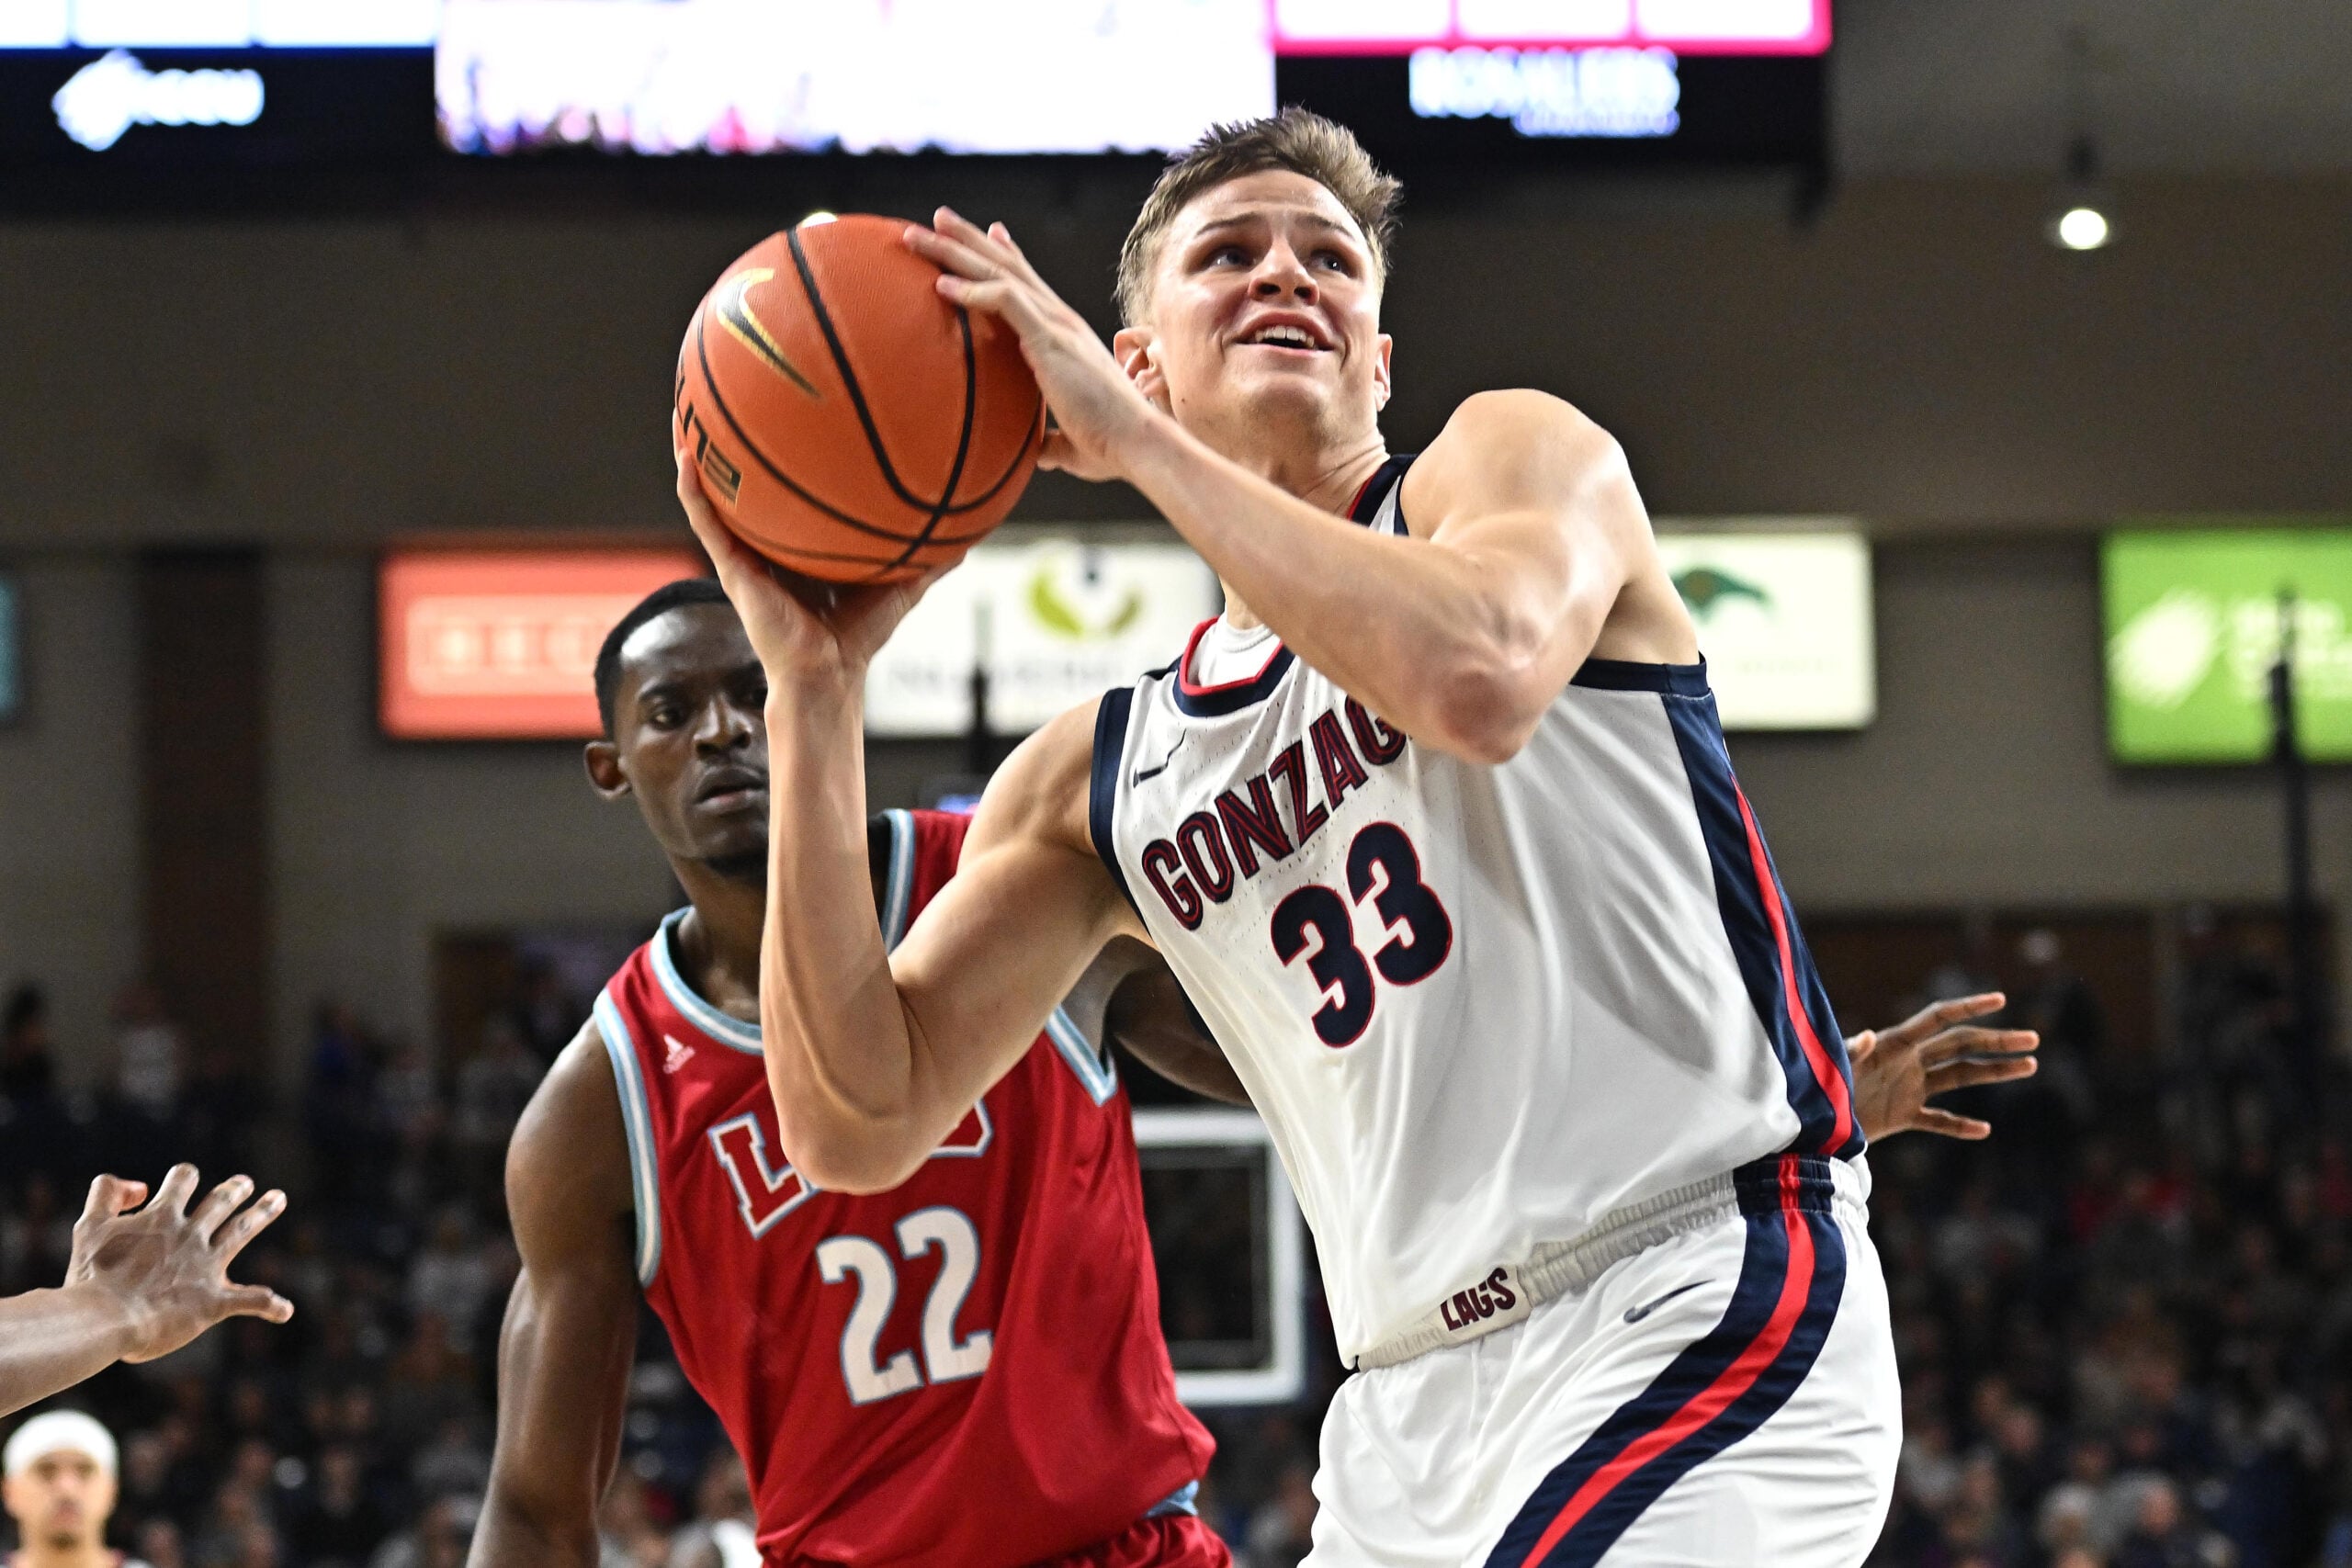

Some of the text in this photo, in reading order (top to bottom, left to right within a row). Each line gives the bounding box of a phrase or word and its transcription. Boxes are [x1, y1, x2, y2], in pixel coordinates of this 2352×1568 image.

[1141, 694, 1408, 931] GONZAG
[1270, 821, 1453, 1049] 33
[816, 1205, 993, 1406] 22
